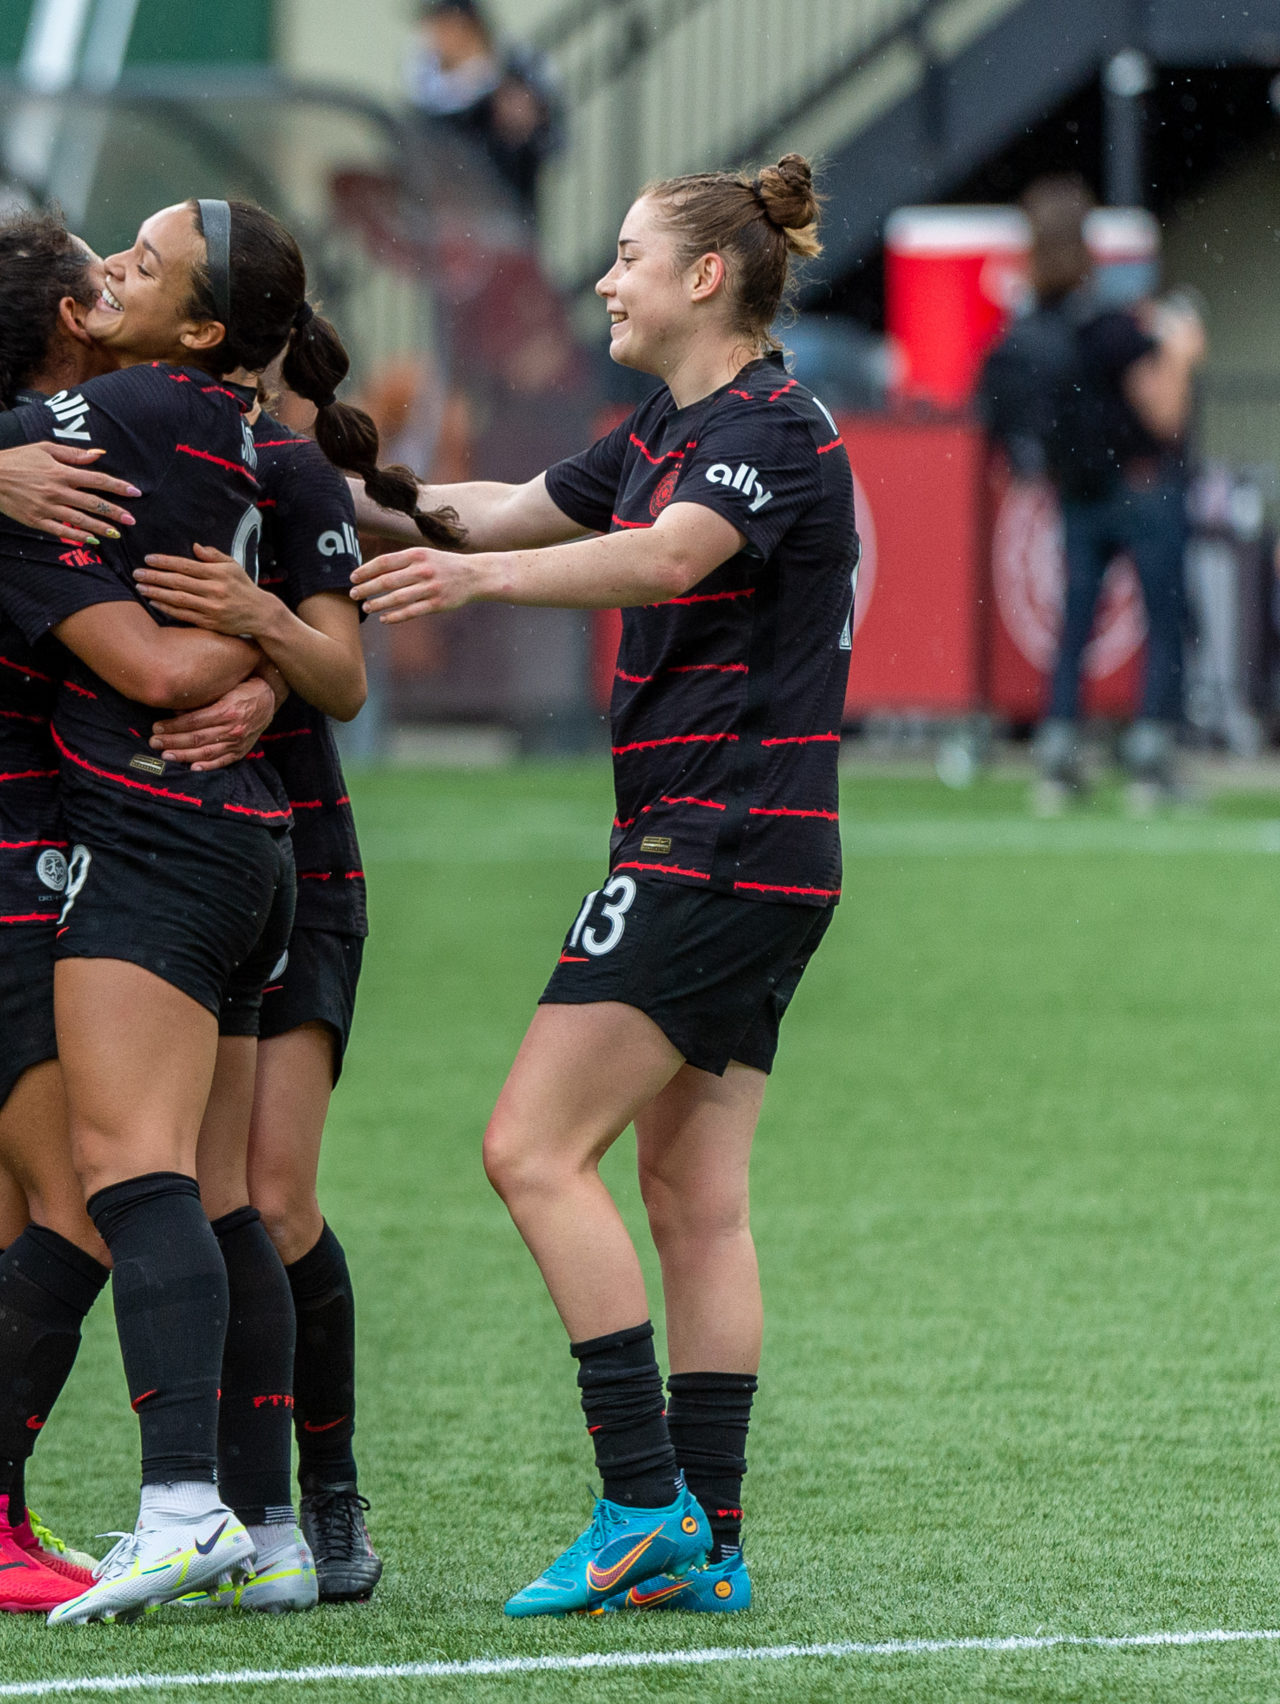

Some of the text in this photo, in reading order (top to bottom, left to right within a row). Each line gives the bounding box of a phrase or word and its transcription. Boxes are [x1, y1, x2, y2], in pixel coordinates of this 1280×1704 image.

[44, 390, 92, 441] ally
[705, 463, 773, 512] ally
[568, 875, 637, 956] 13
